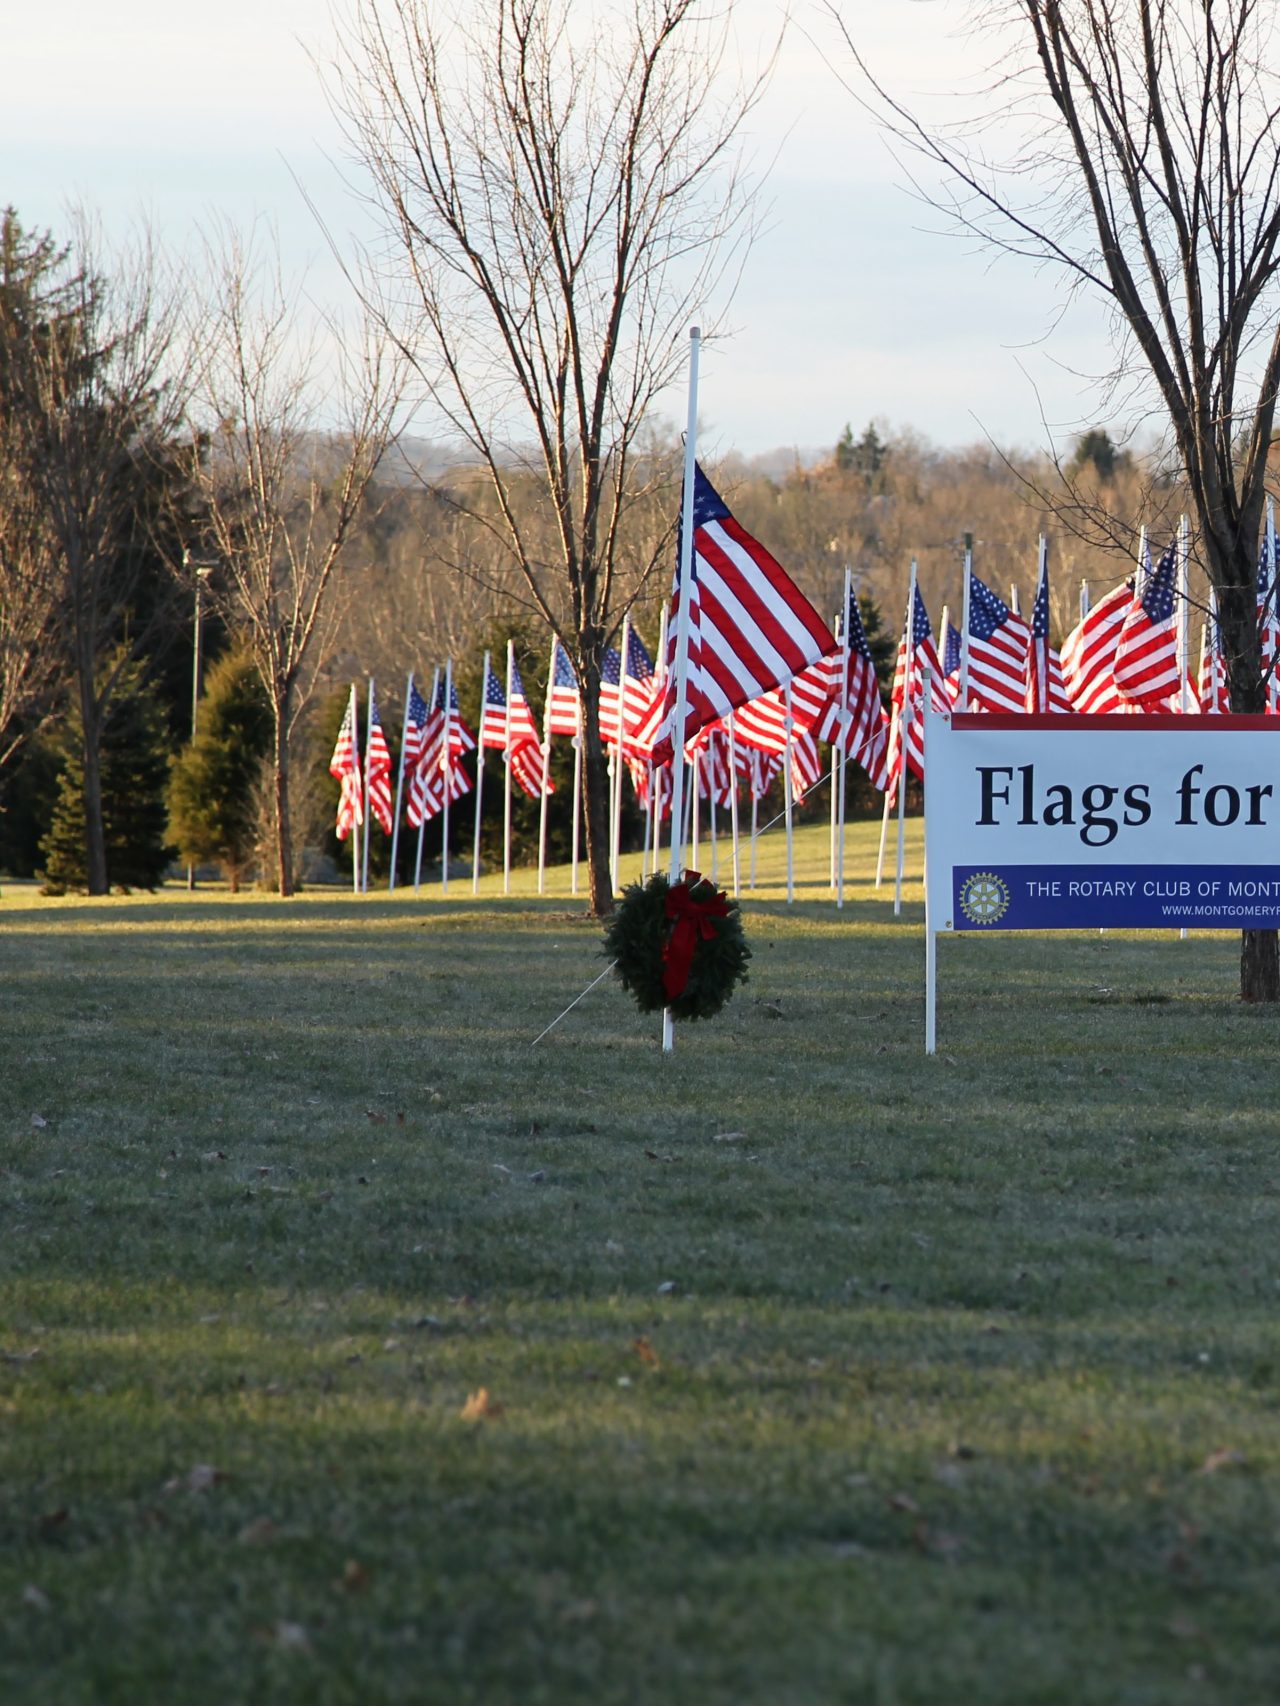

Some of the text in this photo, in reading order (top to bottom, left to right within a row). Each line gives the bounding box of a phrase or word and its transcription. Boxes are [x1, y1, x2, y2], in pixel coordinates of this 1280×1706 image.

[974, 763, 1152, 847] Flags
[1174, 763, 1274, 827] for
[1026, 881, 1062, 897] THE
[1069, 881, 1137, 897] ROTARY
[1143, 881, 1191, 897] CLUB
[1197, 881, 1221, 897] OF
